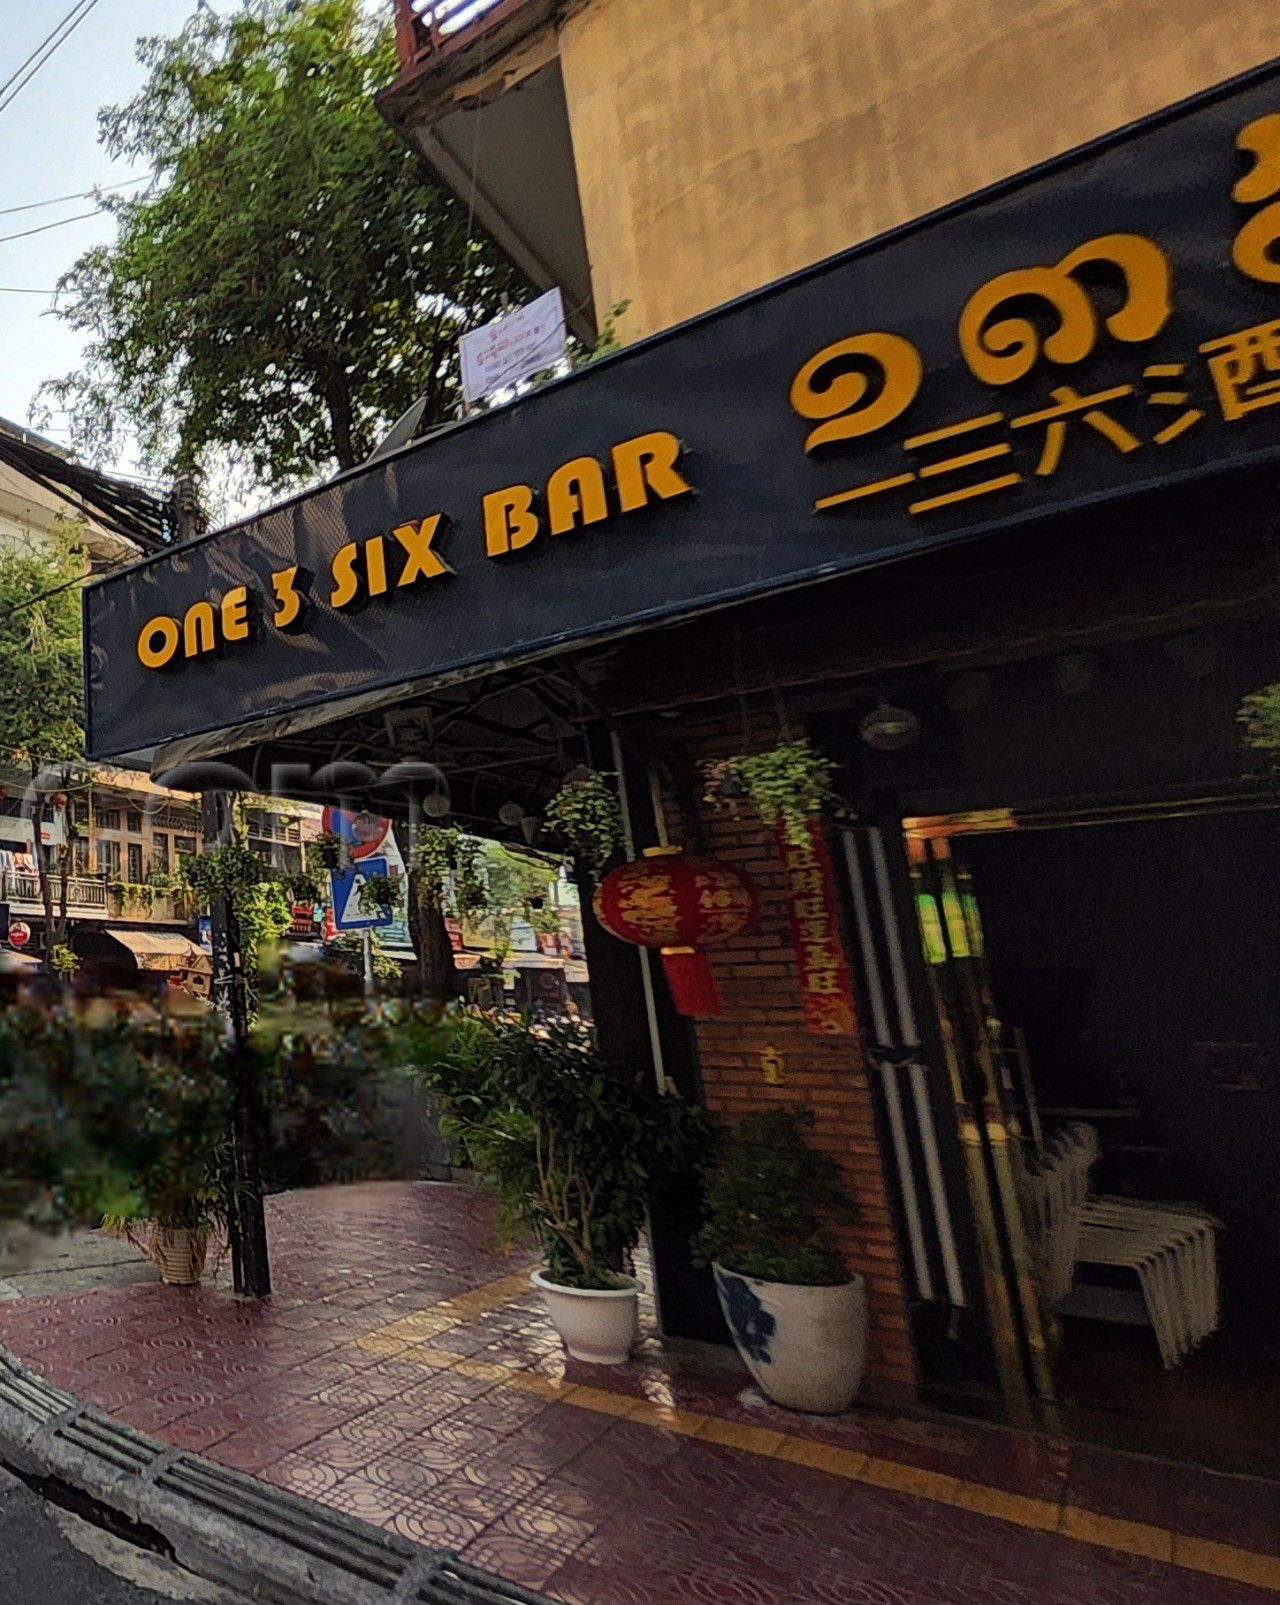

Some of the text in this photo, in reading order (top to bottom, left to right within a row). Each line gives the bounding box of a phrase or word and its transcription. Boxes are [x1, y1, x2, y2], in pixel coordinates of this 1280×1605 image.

[137, 431, 691, 668] ONE 3 SIX BAR
